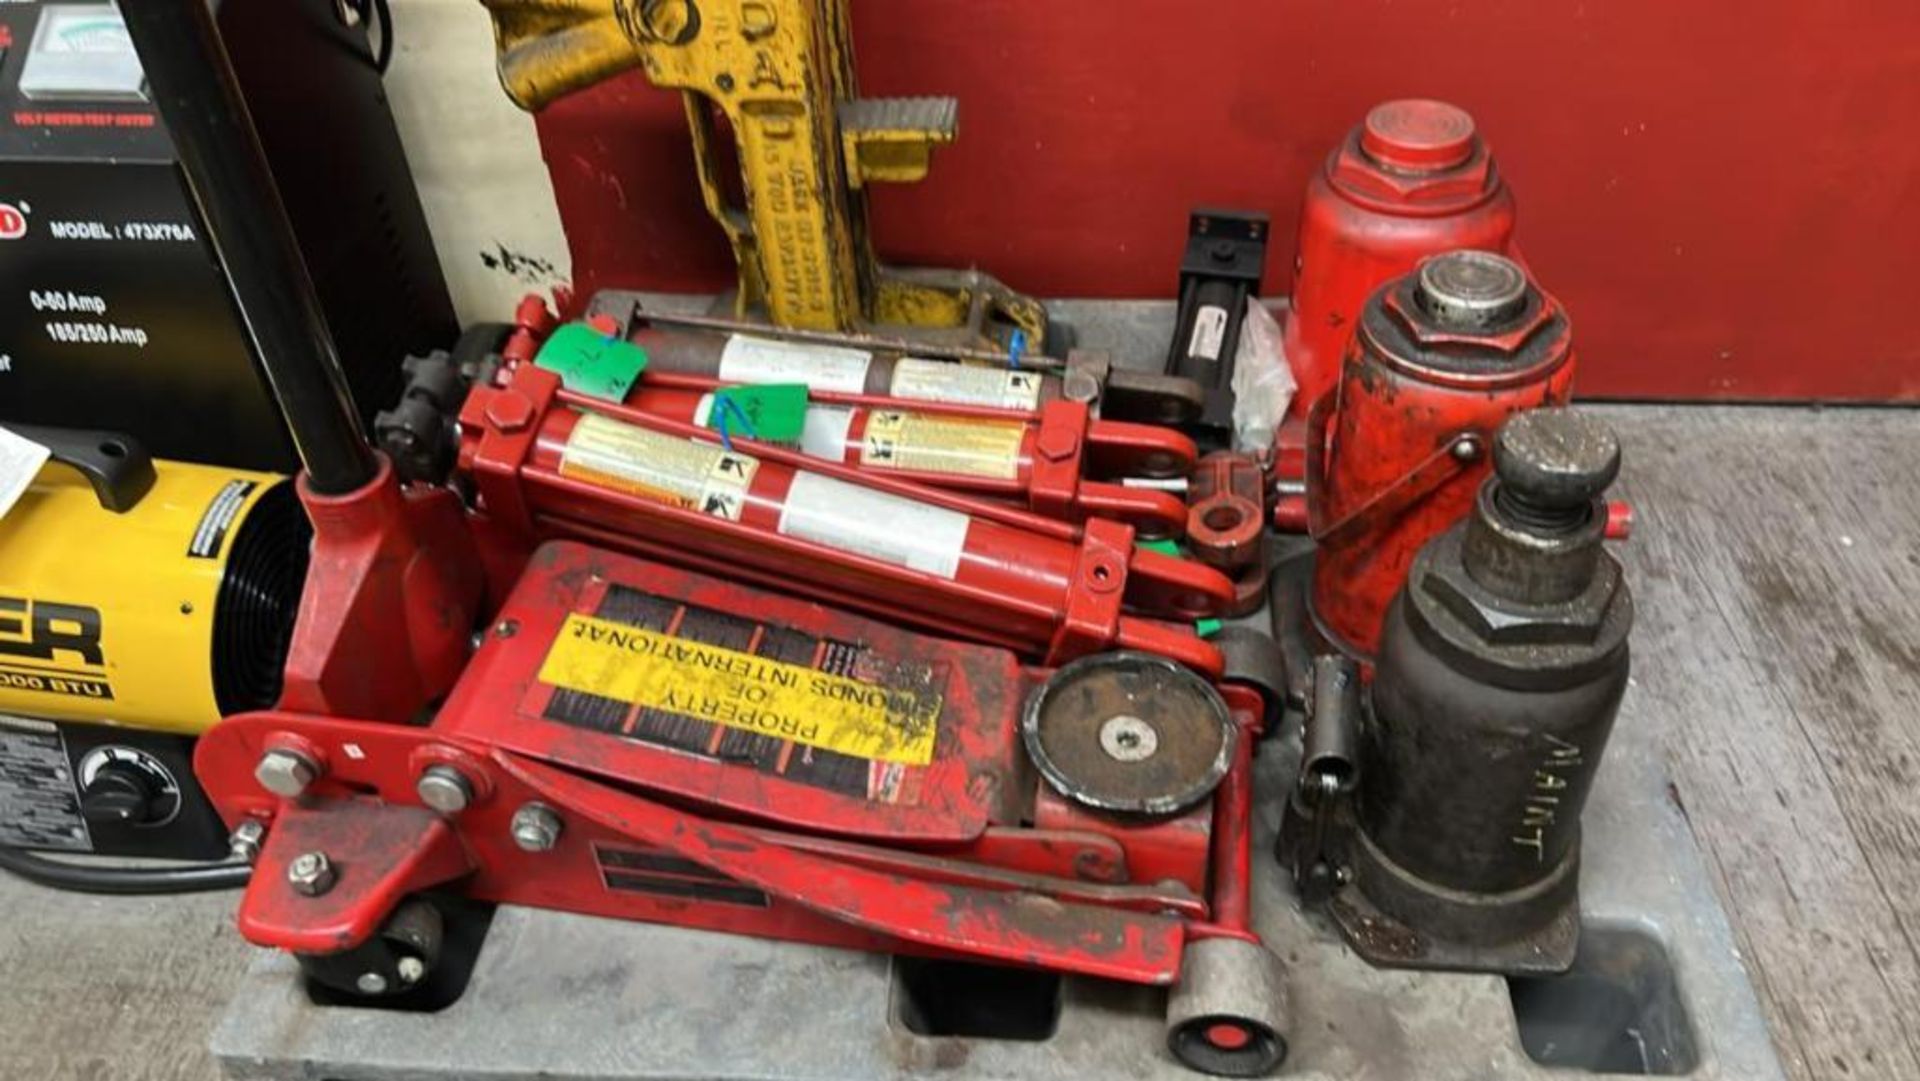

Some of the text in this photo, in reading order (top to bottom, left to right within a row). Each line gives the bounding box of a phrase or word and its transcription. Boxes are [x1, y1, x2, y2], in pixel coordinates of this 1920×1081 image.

[50, 221, 113, 239] MODEL
[67, 291, 106, 316] Amp
[109, 323, 148, 348] Amp
[573, 621, 798, 689] INTERNATIONAL
[49, 678, 102, 697] BTU
[728, 682, 767, 703] OF
[810, 678, 892, 709] ONDS
[666, 688, 819, 740] PROPERTY
[1512, 732, 1583, 864] MAINT
